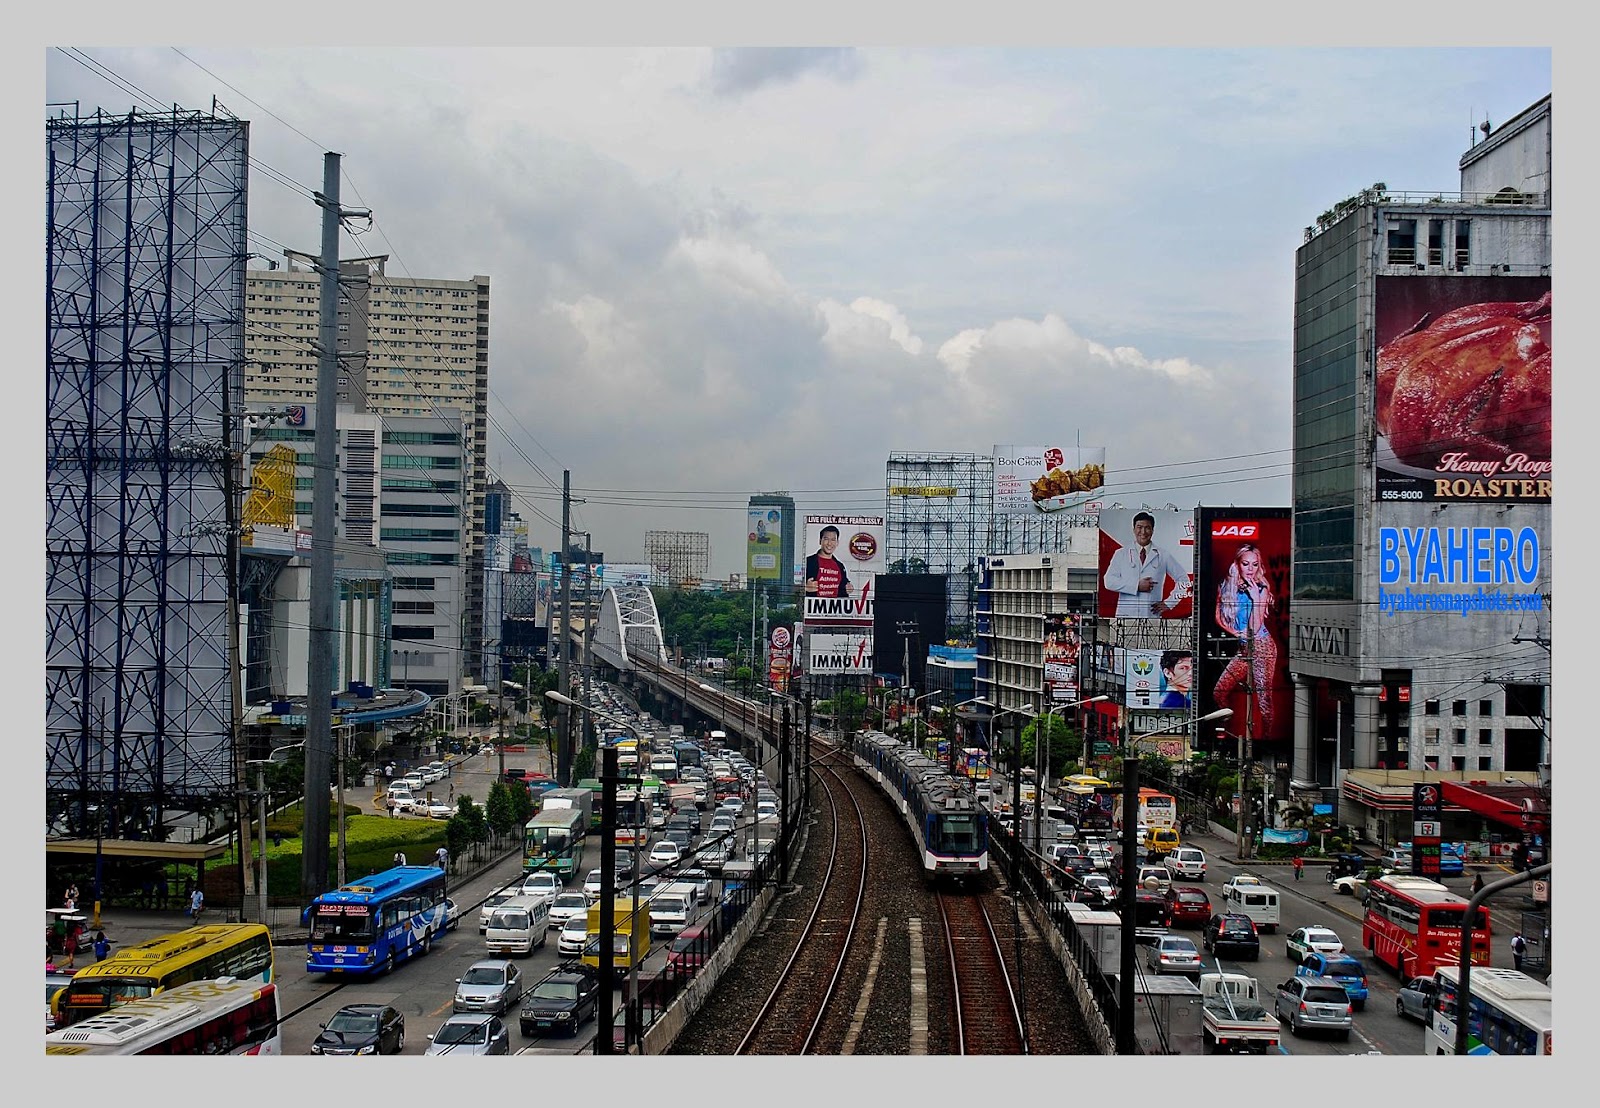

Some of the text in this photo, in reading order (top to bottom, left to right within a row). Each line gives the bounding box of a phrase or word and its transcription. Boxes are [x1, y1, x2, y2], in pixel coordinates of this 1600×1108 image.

[1435, 452, 1500, 478] Kenny
[1382, 491, 1423, 499] 555-9000
[1212, 526, 1256, 536] JAG
